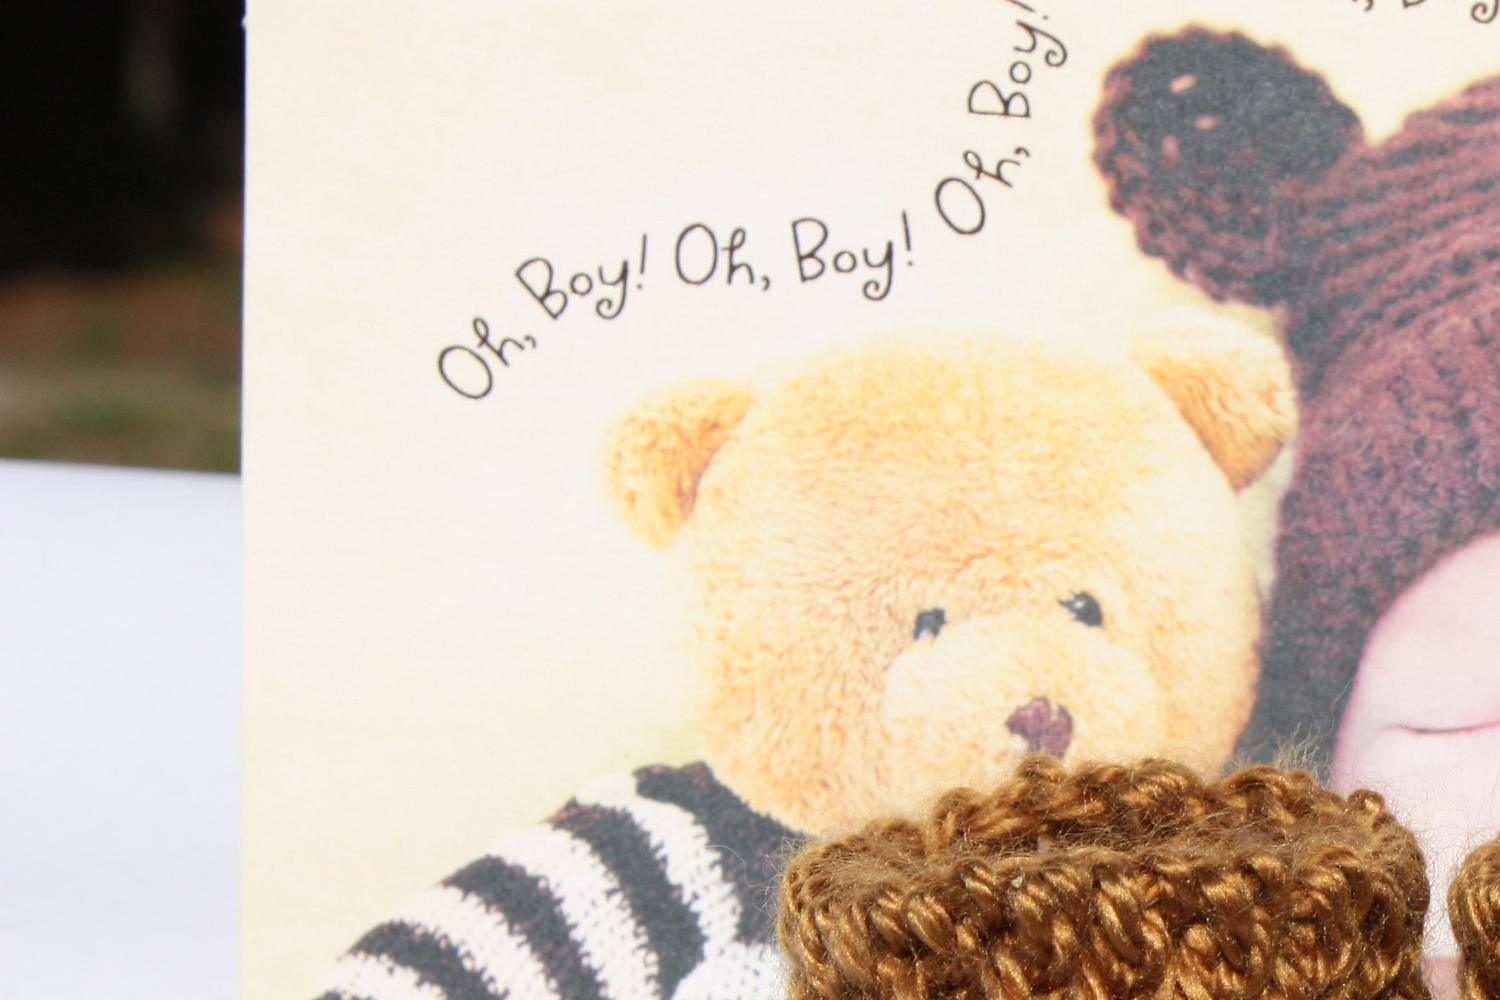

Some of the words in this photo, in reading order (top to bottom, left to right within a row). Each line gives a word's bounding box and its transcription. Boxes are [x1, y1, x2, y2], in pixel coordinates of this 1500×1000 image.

[966, 0, 1068, 118] Boy!
[933, 147, 1031, 236] Oh,
[514, 233, 648, 321] Boy!
[674, 222, 771, 292] Oh,
[790, 209, 914, 302] Boy!
[437, 316, 537, 400] Oh,
